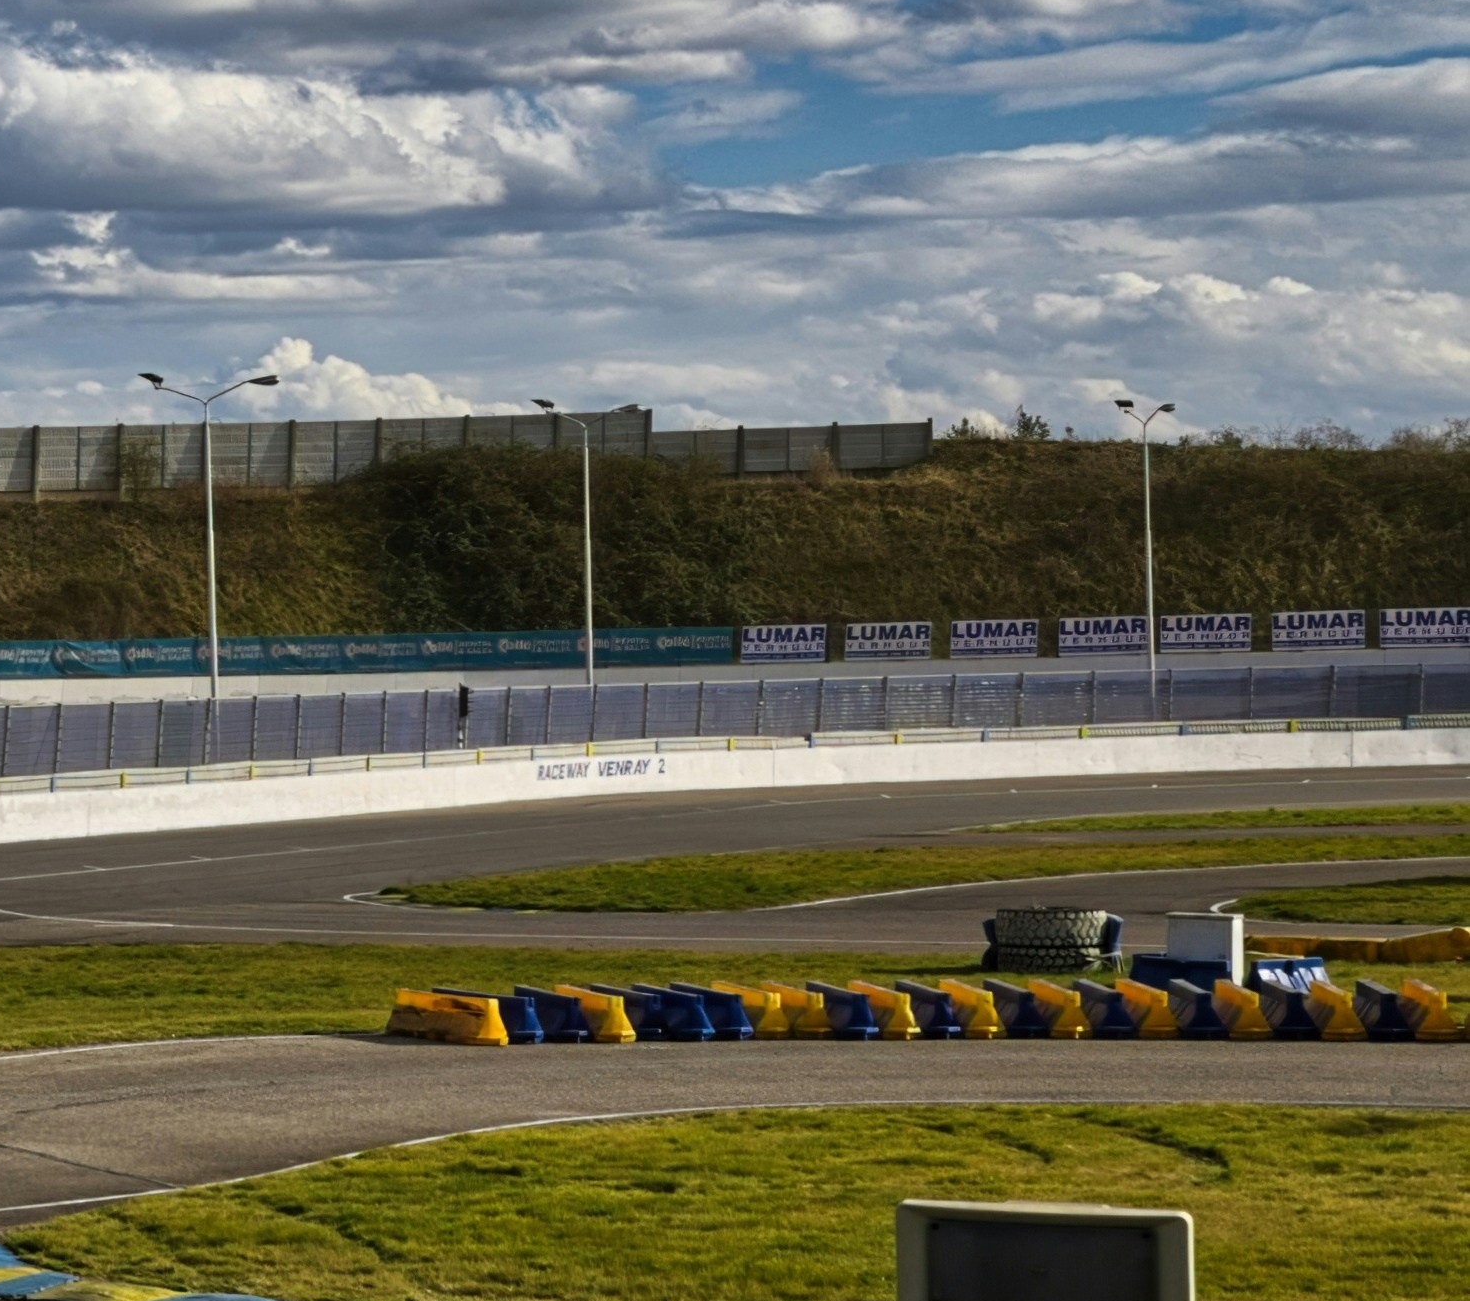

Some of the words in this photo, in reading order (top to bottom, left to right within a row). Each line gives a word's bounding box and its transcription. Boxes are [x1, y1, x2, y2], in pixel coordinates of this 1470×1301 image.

[1060, 618, 1147, 635] LUMAR
[1161, 615, 1250, 632] LUMAR
[1272, 612, 1364, 630] LUMAR
[1381, 609, 1470, 627] LUMAR
[742, 627, 825, 643] LUMAR
[846, 625, 931, 641] LUMAR
[952, 622, 1037, 638] LUMAR
[537, 761, 591, 781] RACEWAY
[598, 758, 651, 777] VENRAY
[658, 758, 666, 774] 2
